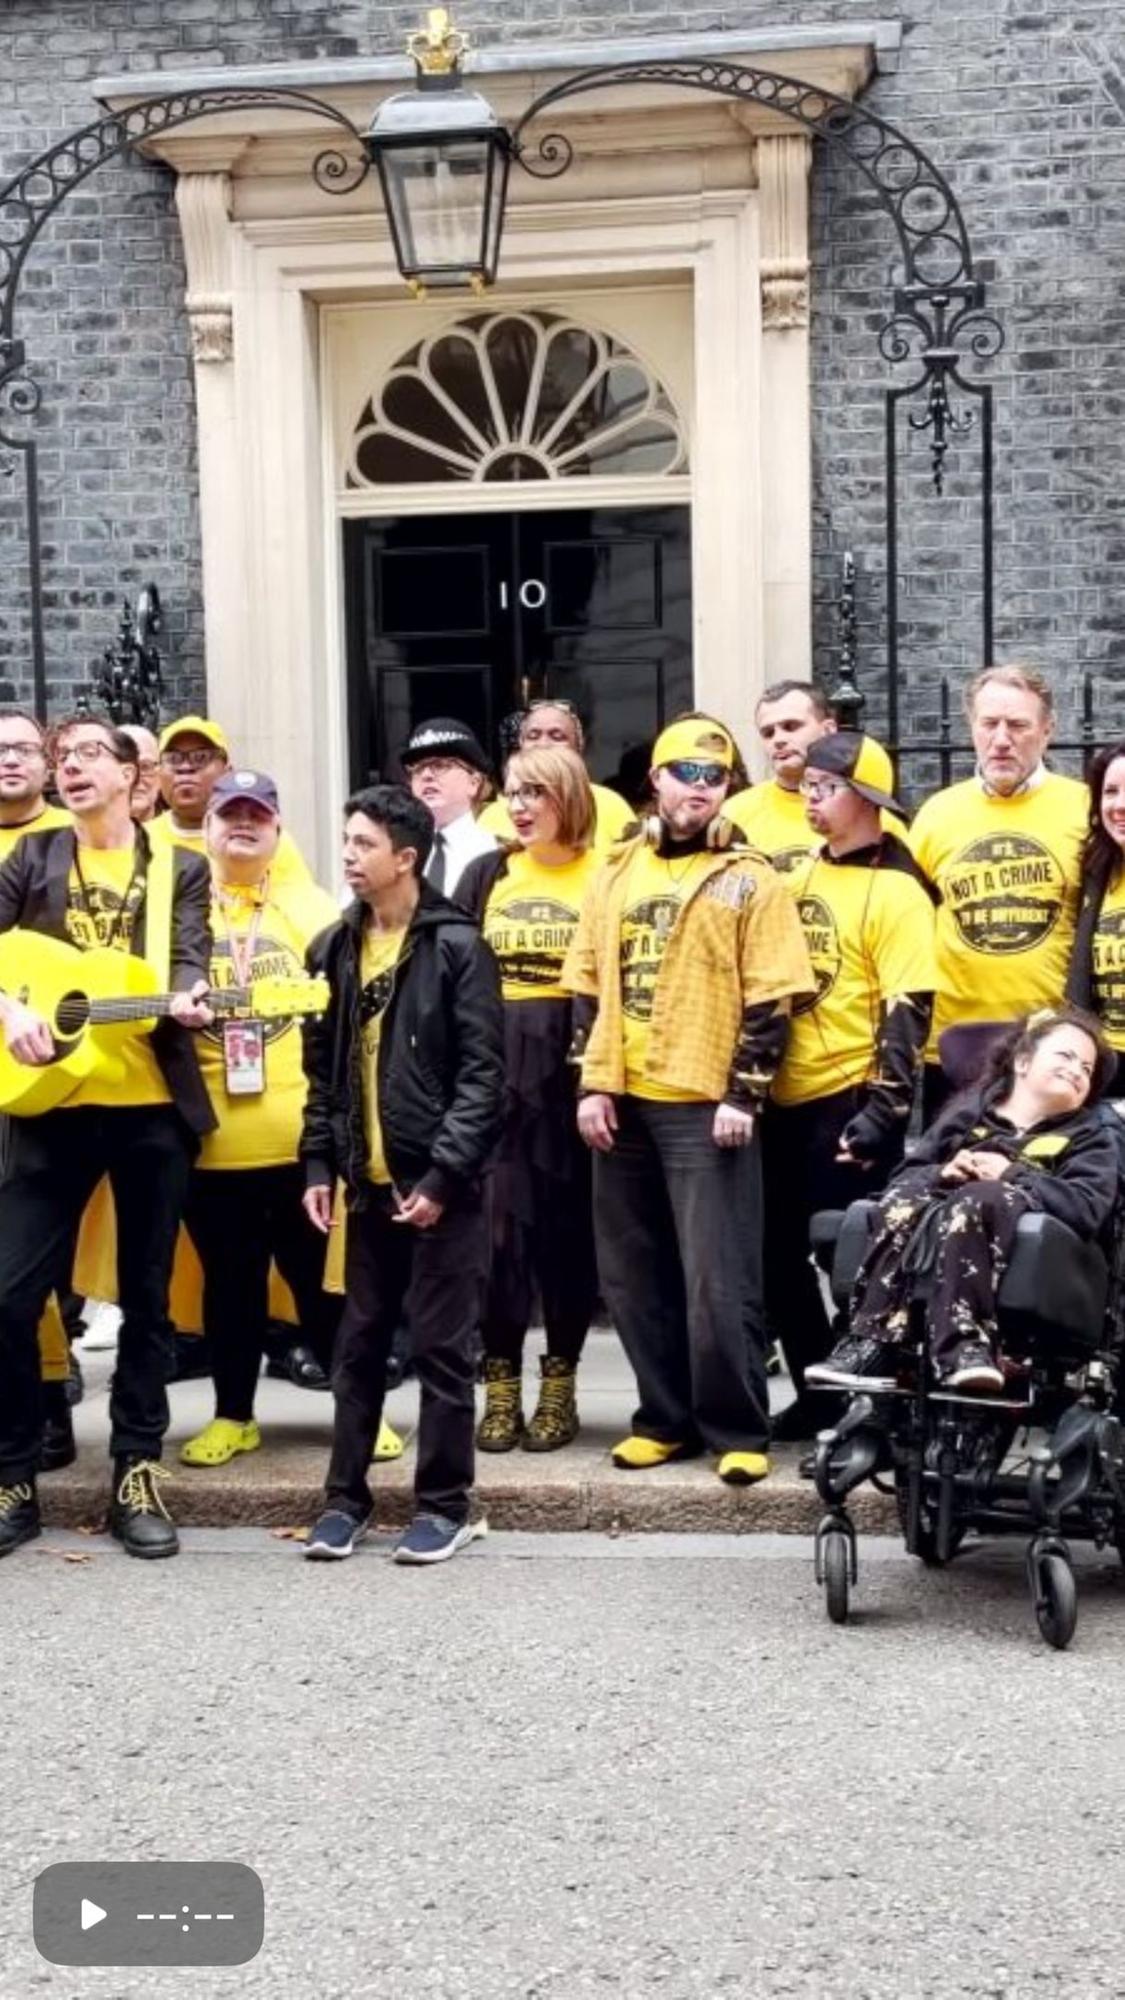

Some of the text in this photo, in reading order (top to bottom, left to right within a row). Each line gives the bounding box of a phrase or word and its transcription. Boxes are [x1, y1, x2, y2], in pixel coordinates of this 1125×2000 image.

[499, 578, 547, 610] 10
[951, 861, 1053, 901] NOT A CRIME
[516, 929, 526, 949] A
